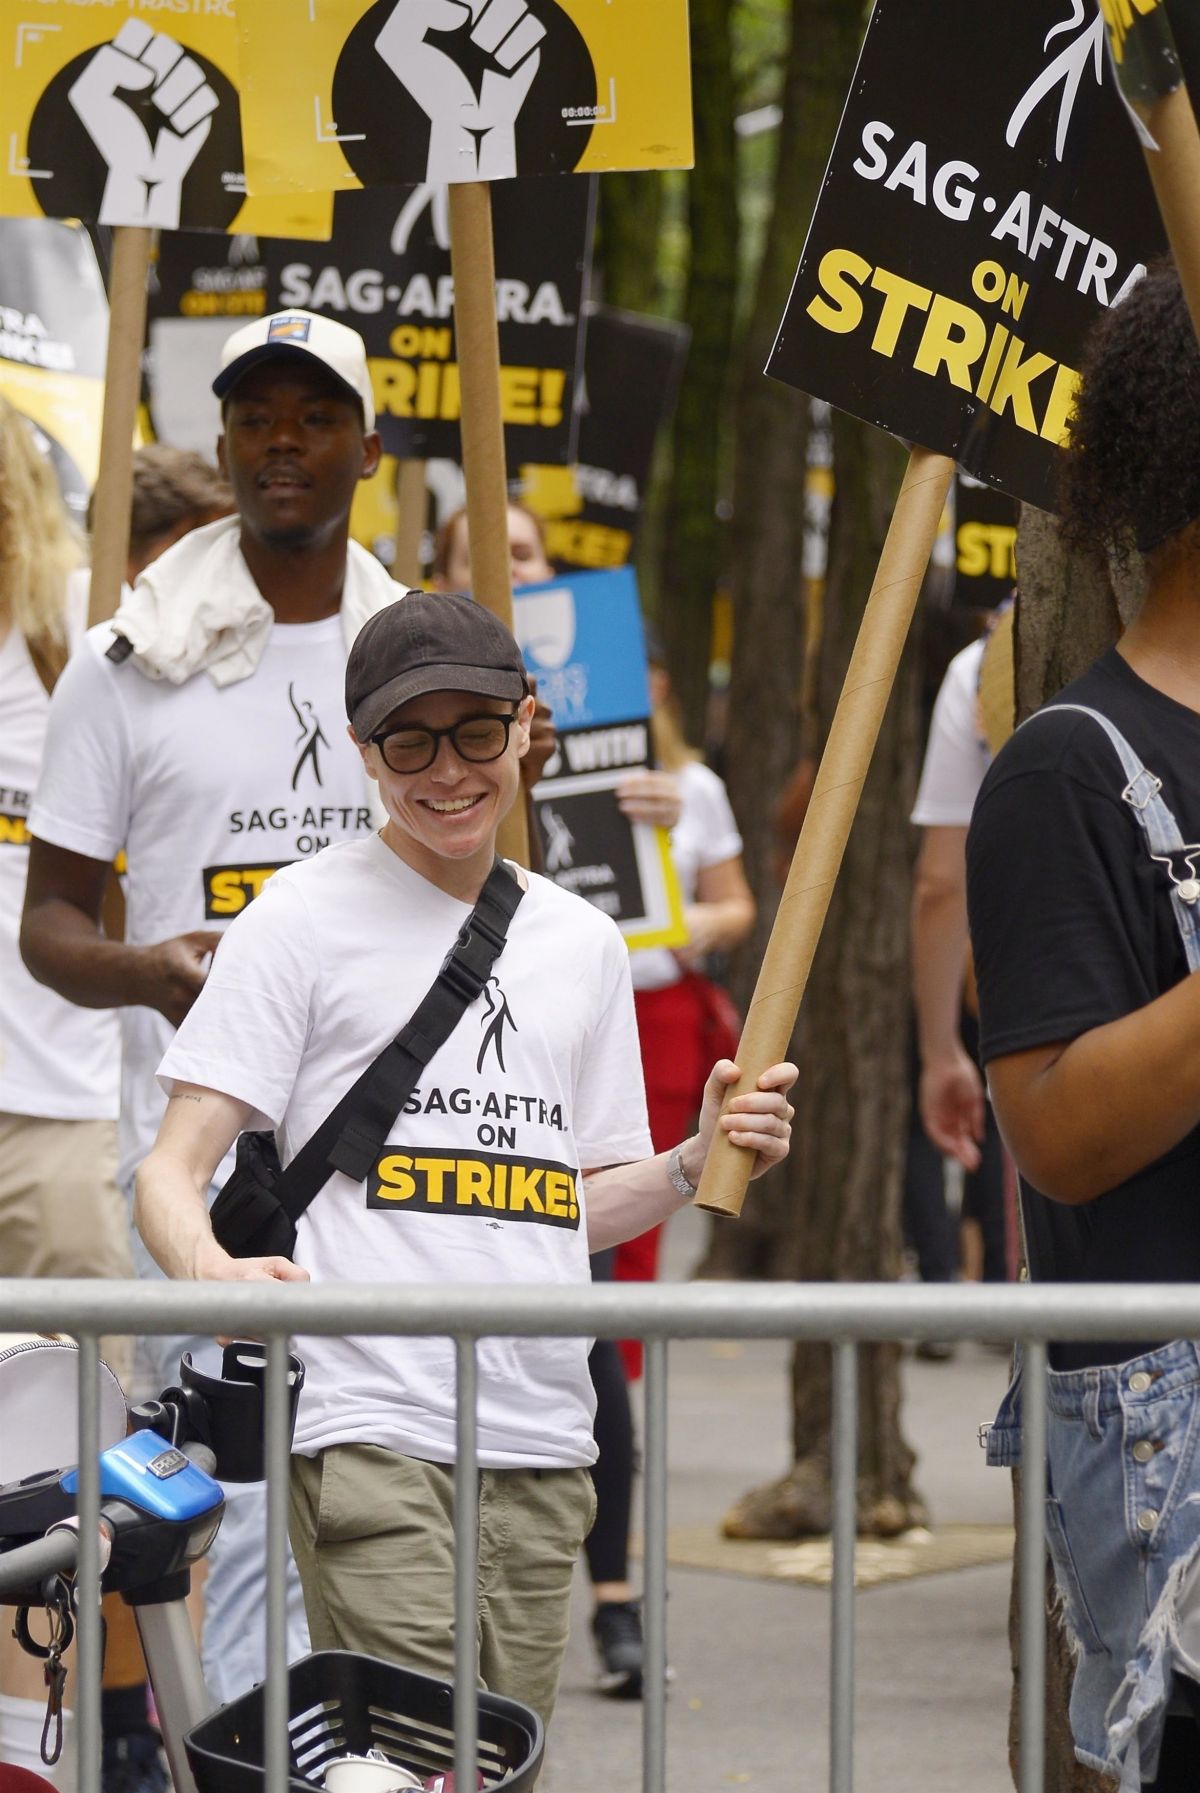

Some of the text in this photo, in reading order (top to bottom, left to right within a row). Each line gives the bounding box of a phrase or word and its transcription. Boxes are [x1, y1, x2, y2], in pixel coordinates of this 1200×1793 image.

[972, 260, 1030, 322] ON
[389, 324, 452, 361] ON
[957, 521, 1018, 580] ST
[564, 723, 648, 772] WITH
[477, 1123, 516, 1149] ON
[376, 1154, 578, 1221] STRIKE!
